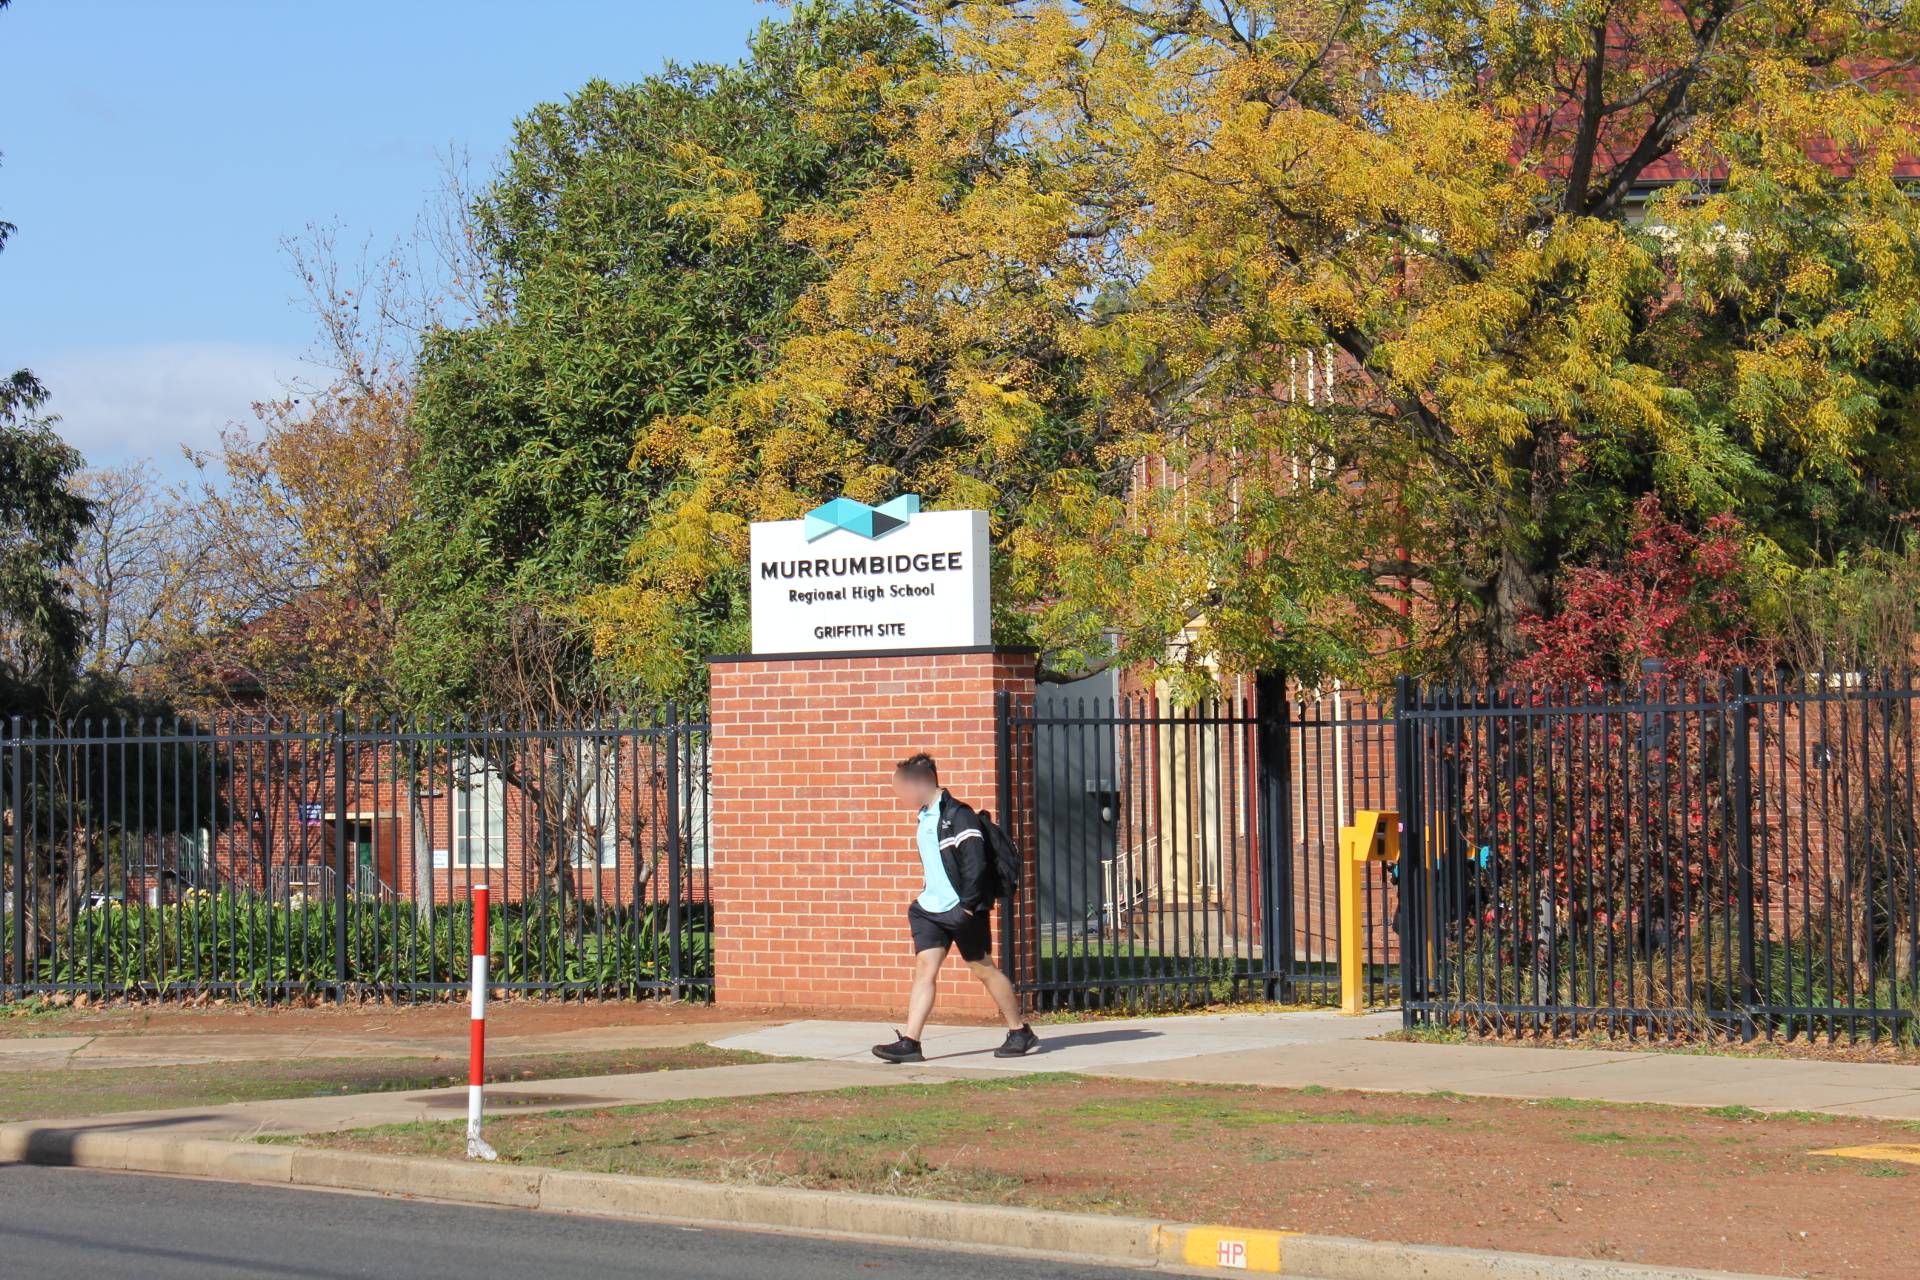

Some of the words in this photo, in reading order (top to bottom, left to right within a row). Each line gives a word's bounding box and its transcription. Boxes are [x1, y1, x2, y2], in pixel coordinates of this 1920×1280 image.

[761, 551, 962, 580] MURRUMBIDGEE
[789, 588, 847, 605] Regional
[852, 586, 885, 604] High
[890, 583, 935, 598] School
[814, 625, 873, 639] GRIFFITH
[878, 623, 906, 637] SITE
[1218, 1241, 1244, 1265] HP
